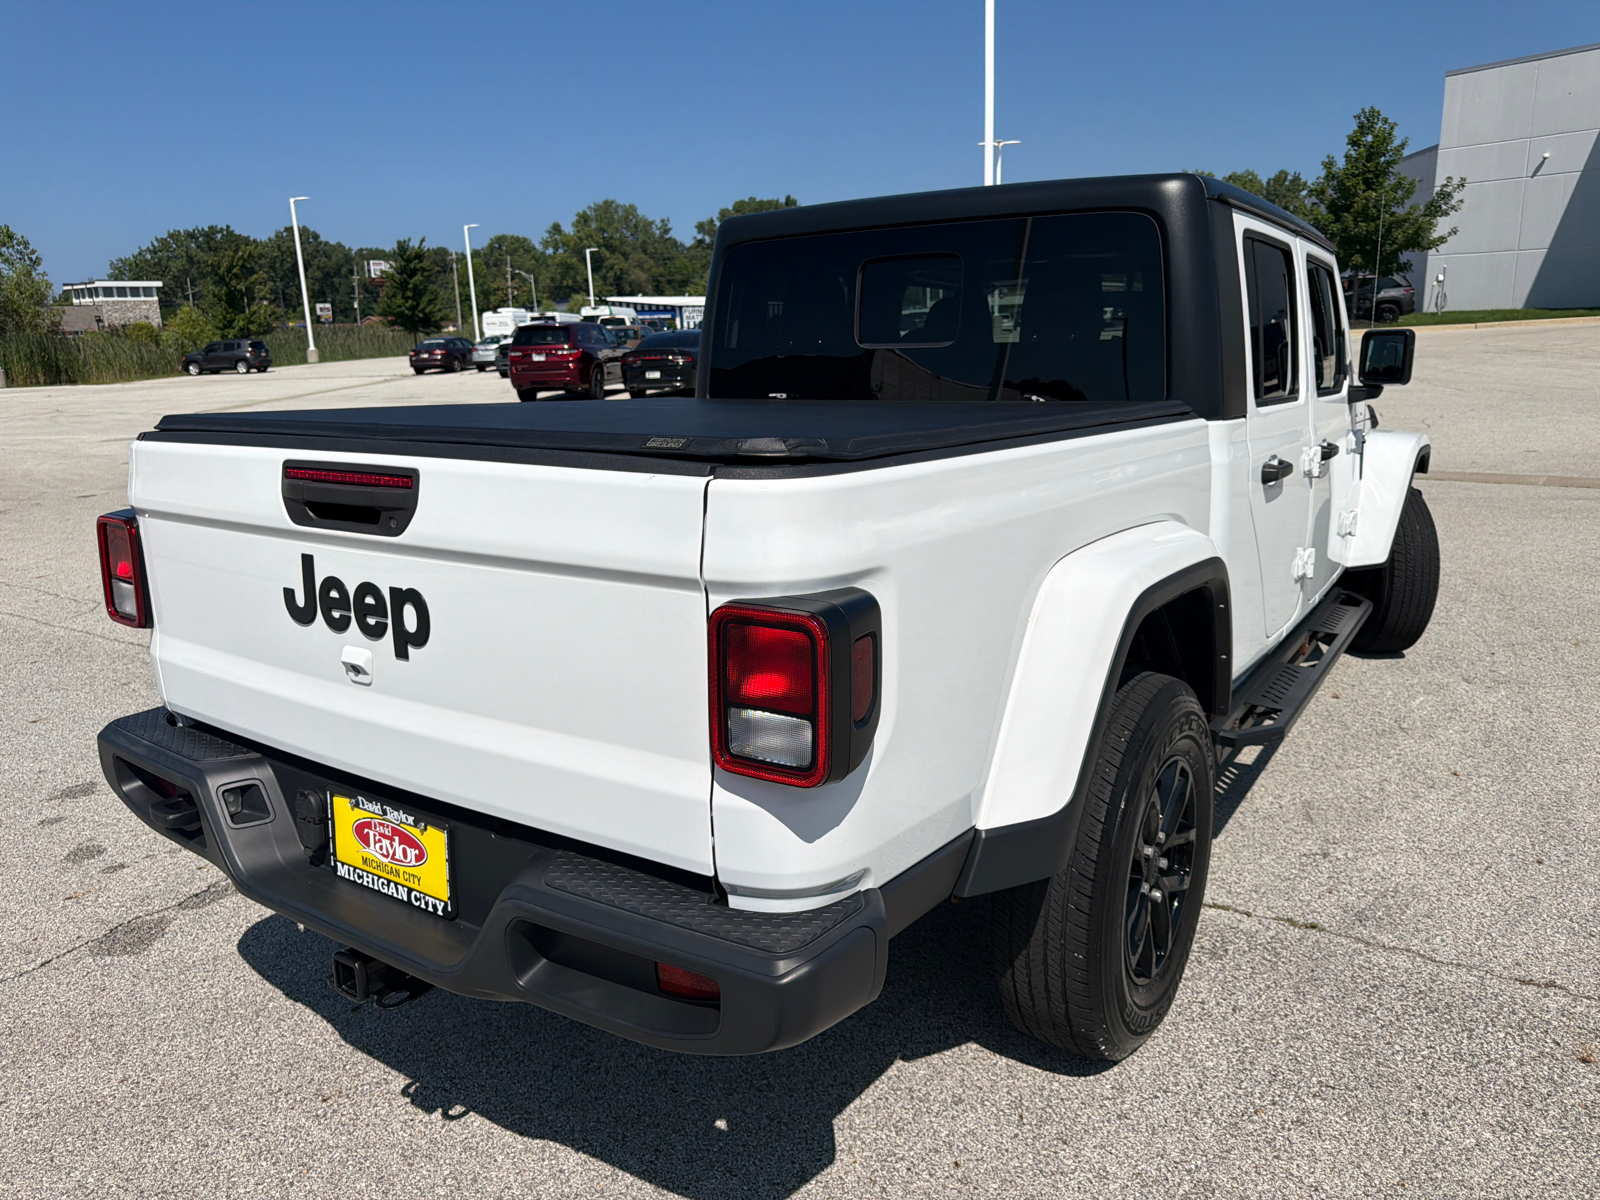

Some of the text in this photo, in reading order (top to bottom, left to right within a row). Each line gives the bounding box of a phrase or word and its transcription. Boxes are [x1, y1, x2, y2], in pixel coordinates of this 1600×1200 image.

[283, 553, 431, 662] Jeep
[357, 796, 415, 824] David Taylor
[371, 820, 392, 836] David
[357, 827, 419, 864] Taylor
[361, 855, 422, 887] MICHIGAN CITY
[336, 861, 409, 902] MICHIGAN
[411, 890, 445, 916] CITY
